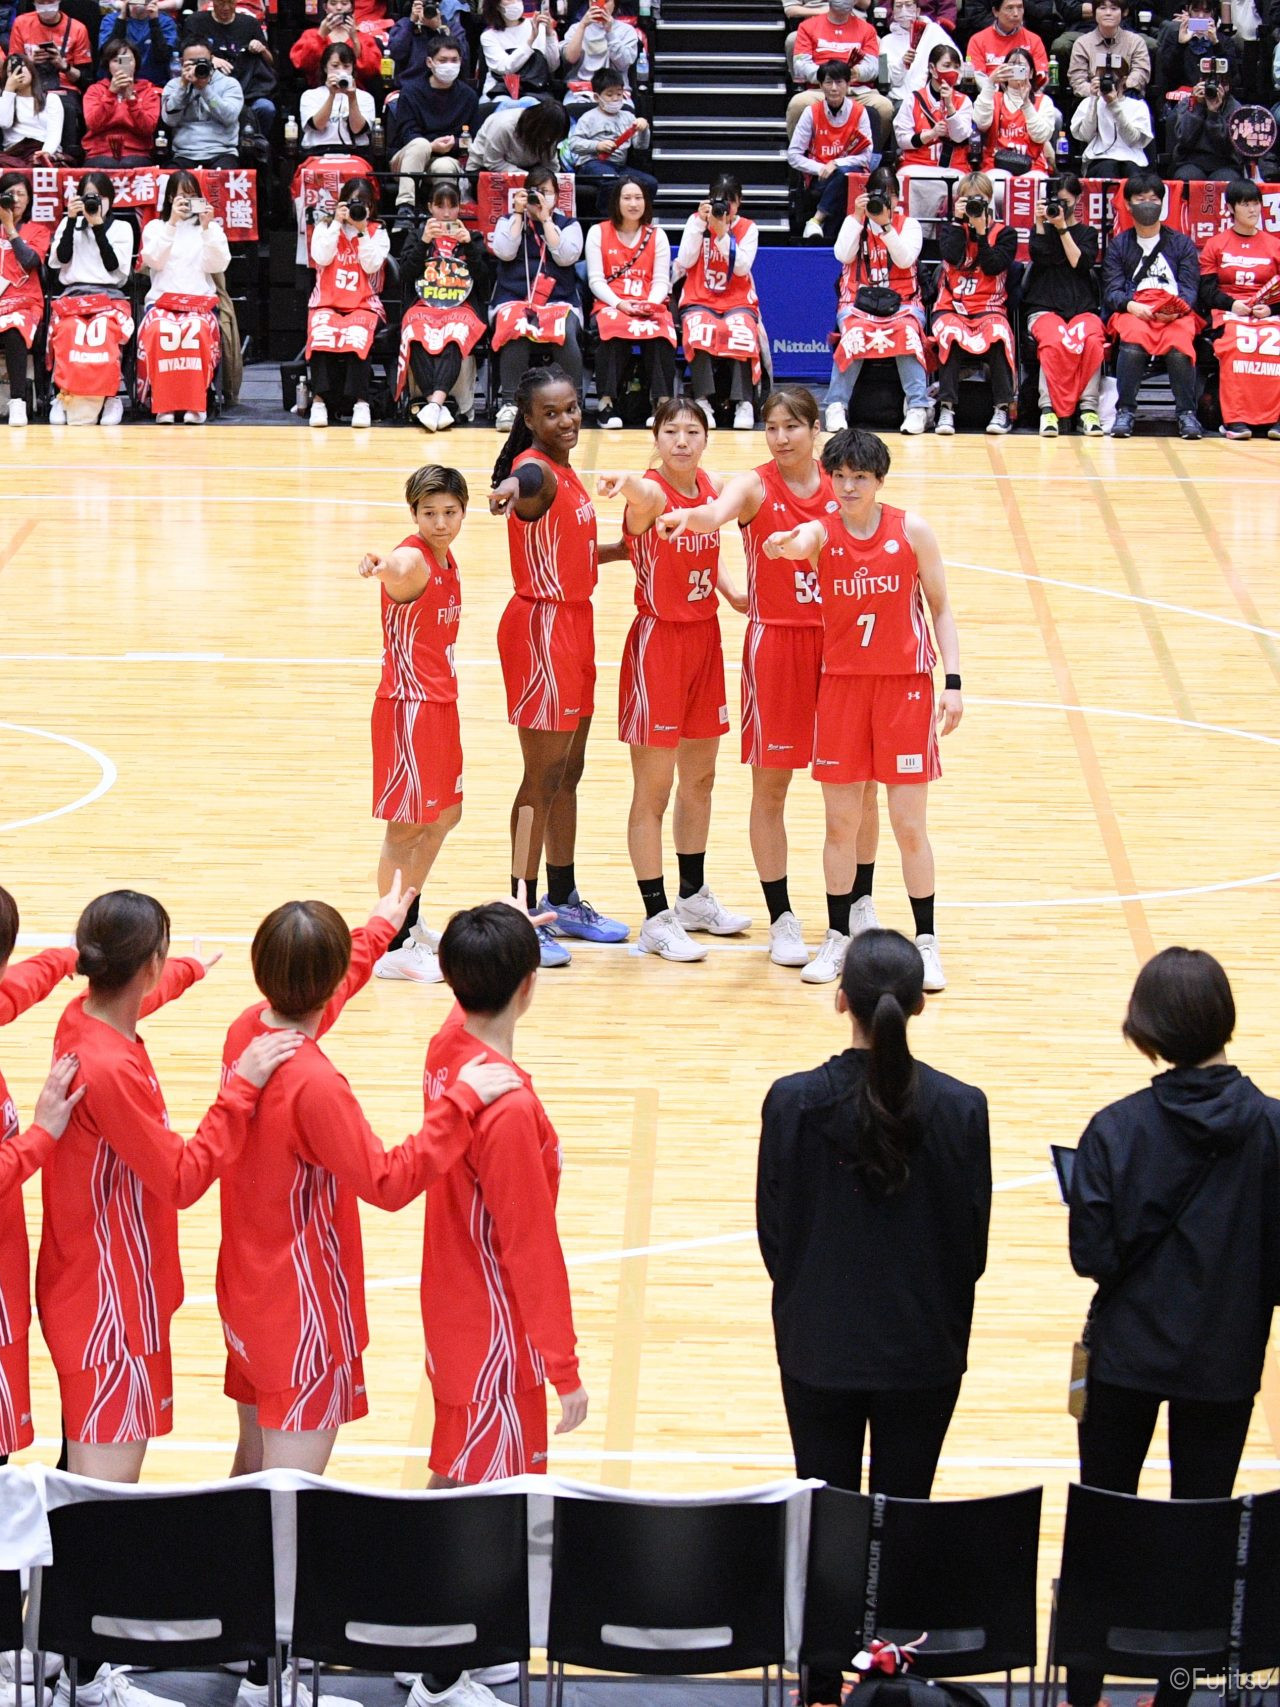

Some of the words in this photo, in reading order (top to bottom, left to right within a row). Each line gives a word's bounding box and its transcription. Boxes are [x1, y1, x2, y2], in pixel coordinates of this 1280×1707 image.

[31, 168, 59, 222] 町田
[224, 170, 253, 229] 藤本
[1014, 177, 1031, 216] MAC
[335, 269, 359, 291] 52
[423, 286, 466, 302] FIGHT
[622, 278, 644, 297] 18
[704, 269, 727, 291] 52
[953, 276, 978, 295] 25
[1234, 271, 1256, 286] 52
[74, 317, 108, 347] 10
[159, 318, 202, 352] 52
[773, 339, 830, 354] Nittaku
[1236, 324, 1280, 356] 52
[158, 357, 203, 374] MIYAZAWA
[687, 568, 713, 602] 25
[793, 570, 823, 605] 52
[833, 570, 900, 601] FUJITSU
[856, 612, 877, 649] 7
[872, 1493, 887, 1528] UND
[1236, 1511, 1253, 1566] UNDER
[866, 1540, 882, 1608] ARMOUR
